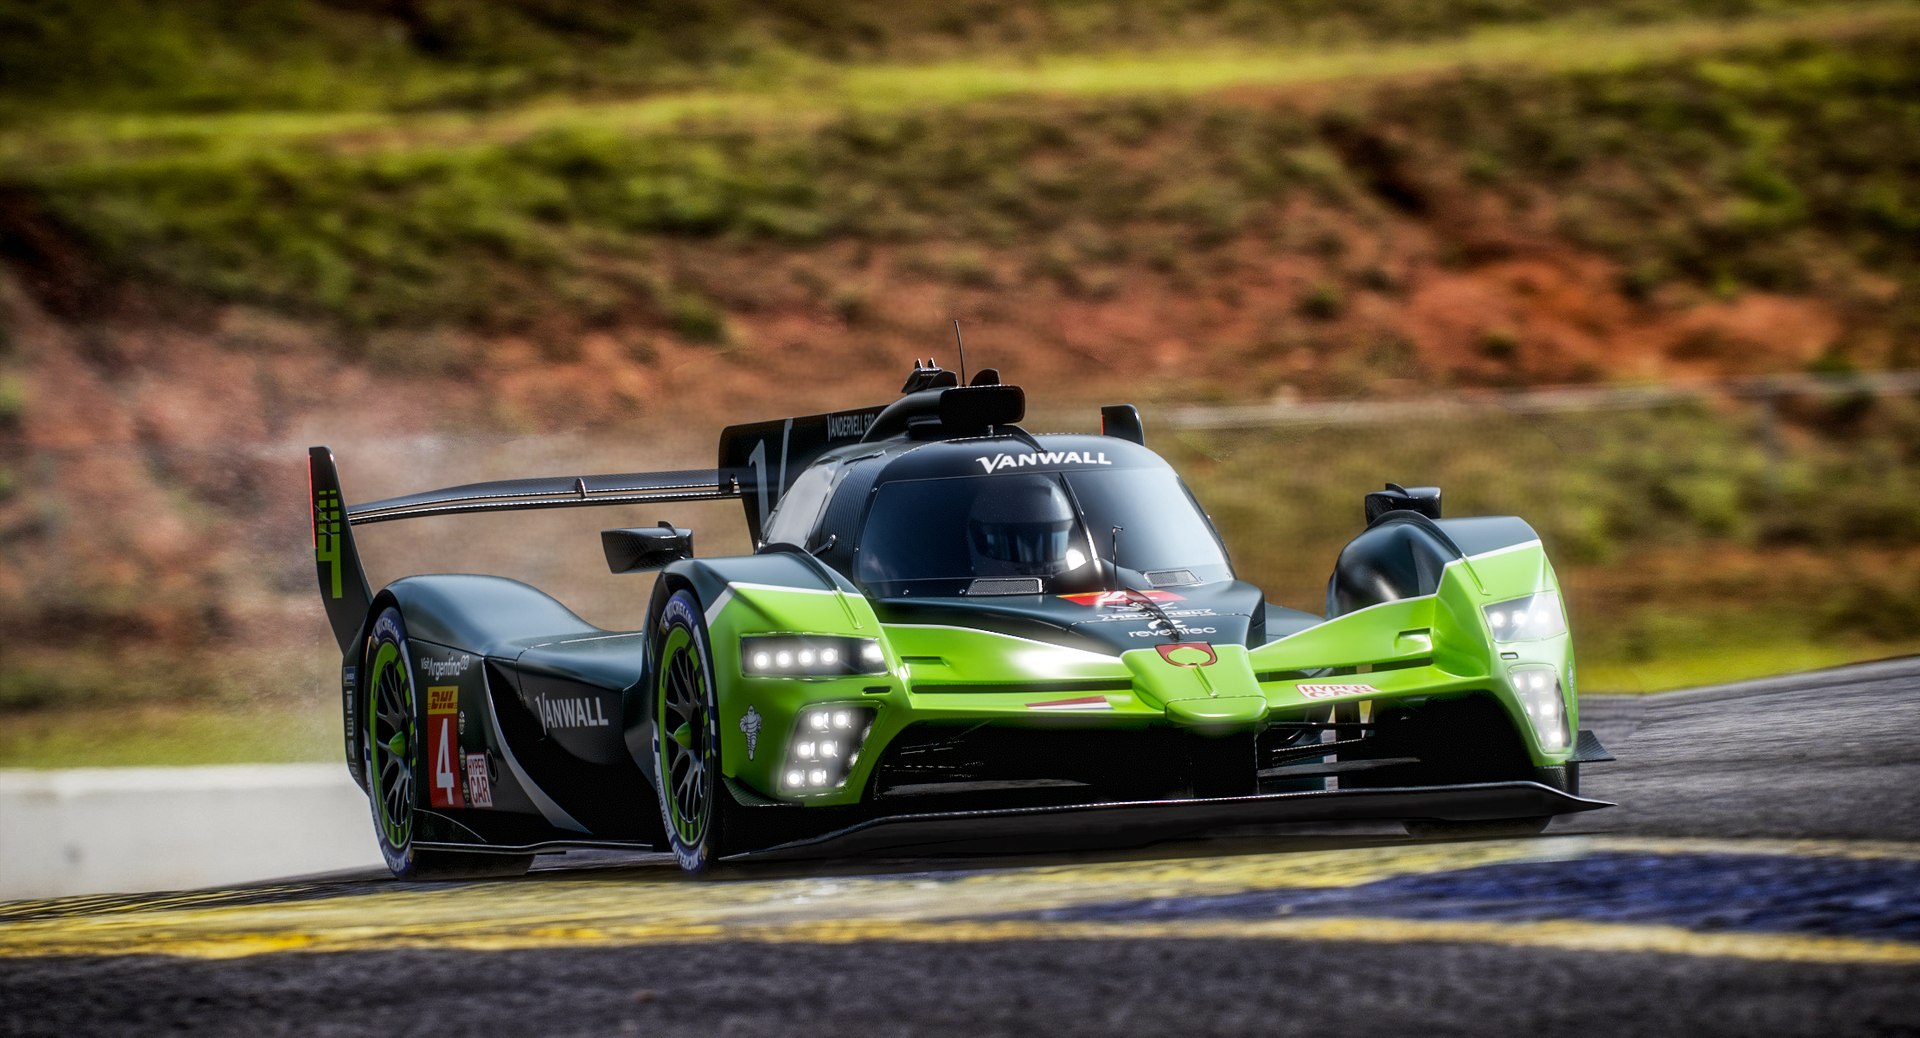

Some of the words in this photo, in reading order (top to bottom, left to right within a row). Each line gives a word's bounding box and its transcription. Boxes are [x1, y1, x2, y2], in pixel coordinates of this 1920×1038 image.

[976, 452, 1112, 474] VANWALL
[318, 490, 342, 598] 4
[666, 601, 693, 627] MICHELIN
[1128, 627, 1216, 638] reventec
[421, 657, 429, 670] Visit
[428, 656, 461, 680] Argentina
[431, 691, 454, 709] DHL
[535, 692, 609, 736] VANWALL
[436, 718, 454, 805] 4
[468, 759, 485, 775] HYPER
[470, 777, 490, 803] CAR
